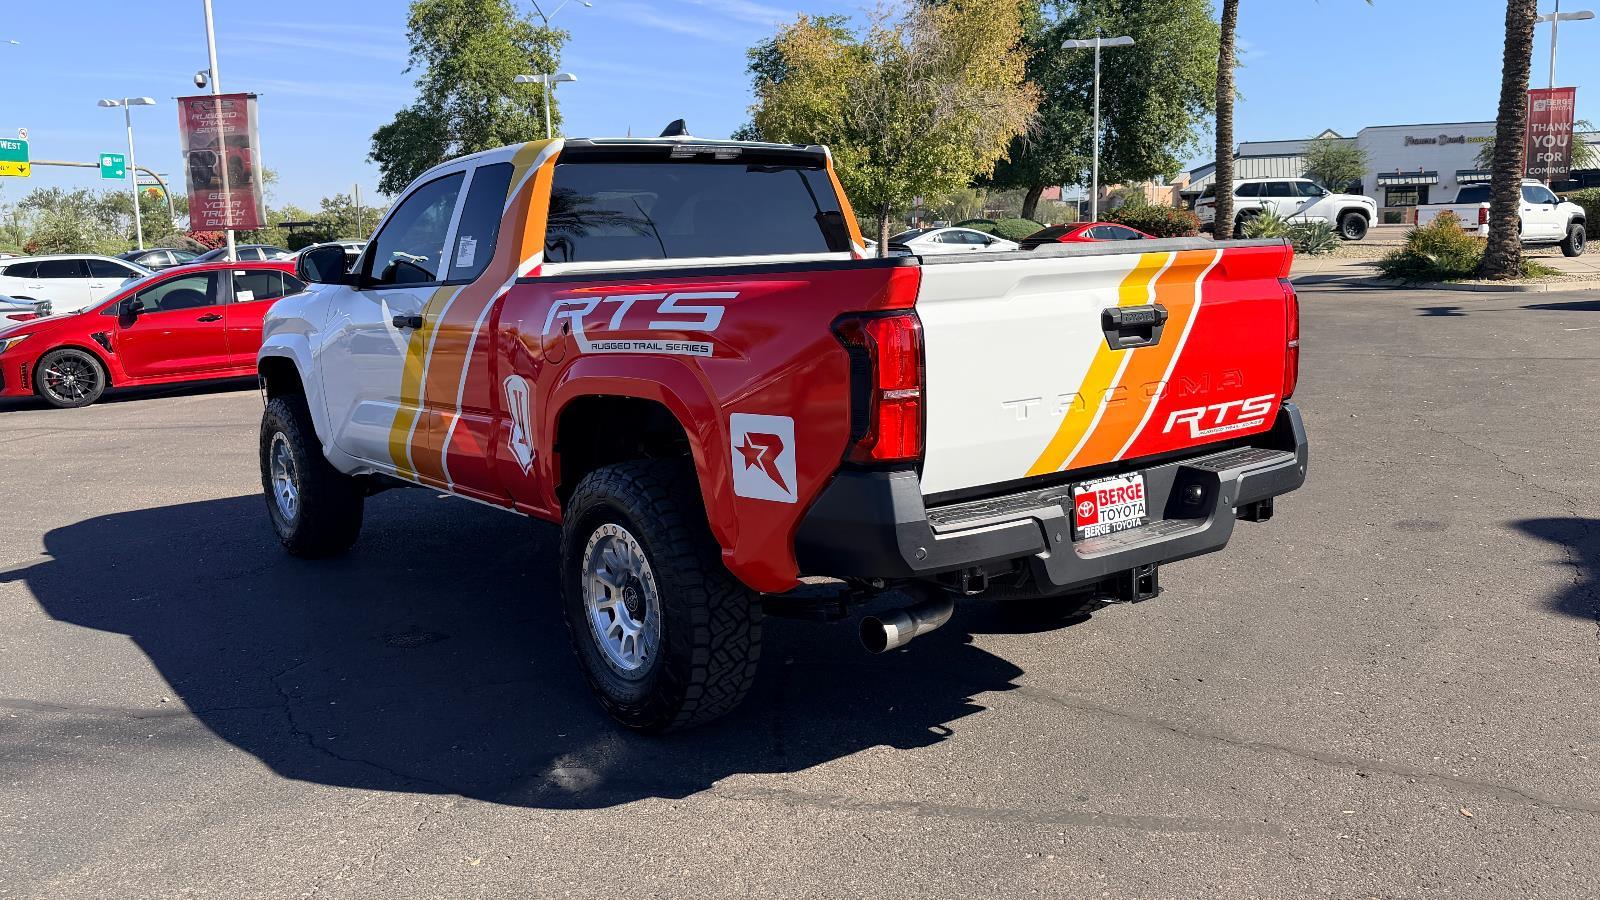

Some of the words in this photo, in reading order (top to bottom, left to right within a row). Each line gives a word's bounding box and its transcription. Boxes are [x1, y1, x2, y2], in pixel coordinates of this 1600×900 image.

[1546, 98, 1573, 106] BERGE
[192, 111, 236, 120] RUGGED
[1531, 122, 1570, 132] THANK
[0, 140, 21, 150] WEST
[1532, 134, 1569, 148] YOU
[1536, 152, 1562, 162] FOR
[1528, 166, 1569, 175] COMING!
[208, 192, 236, 200] GET
[204, 200, 242, 209] YOUR
[201, 209, 246, 218] TRUCK
[541, 291, 740, 354] RTS
[591, 342, 631, 351] RUGGED
[633, 343, 663, 351] TRAIL
[665, 343, 709, 353] SERIES
[1000, 368, 1244, 422] TACOMA
[1161, 393, 1276, 439] RTS
[1098, 483, 1143, 506] BERGE
[1100, 503, 1144, 522] TOYOTA
[1084, 525, 1110, 538] BERGE
[1113, 518, 1141, 531] TOYOTA
